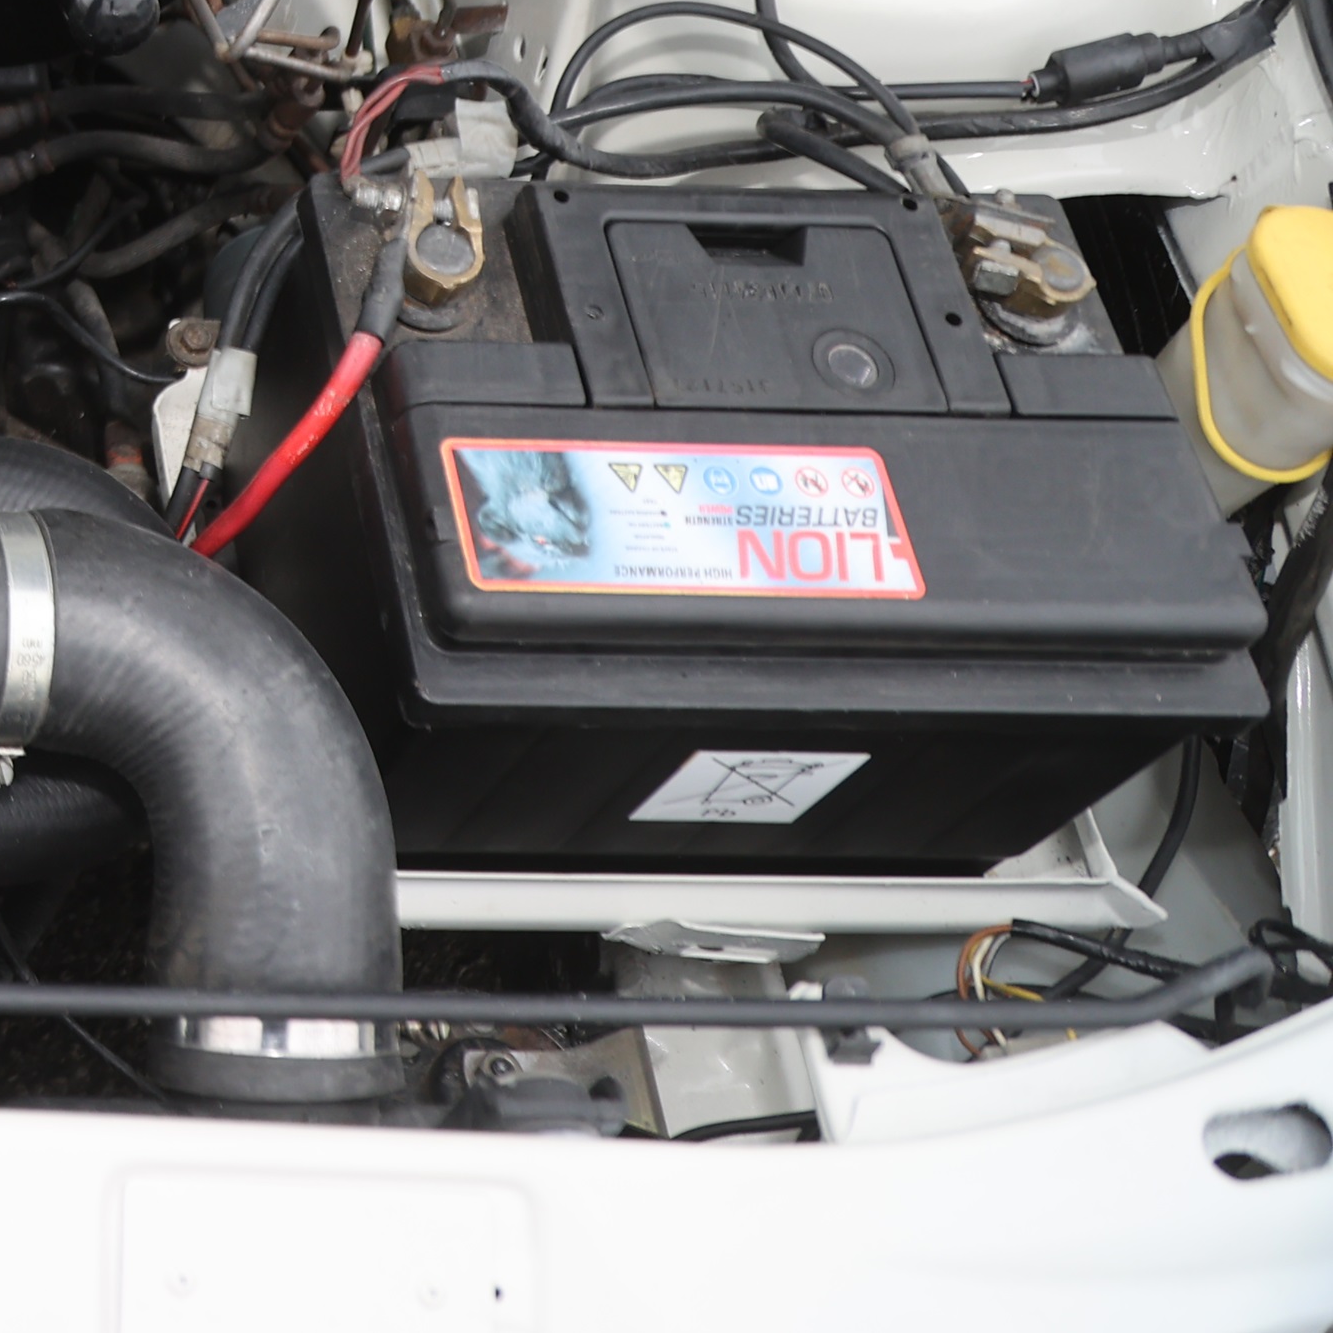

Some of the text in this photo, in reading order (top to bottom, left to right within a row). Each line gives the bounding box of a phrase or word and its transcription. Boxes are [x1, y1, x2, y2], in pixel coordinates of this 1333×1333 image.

[684, 515, 734, 527] STRENGTH
[735, 503, 880, 529] BATTERIES
[736, 529, 886, 583] LION
[613, 564, 733, 580] HIGH PERFORMANCE
